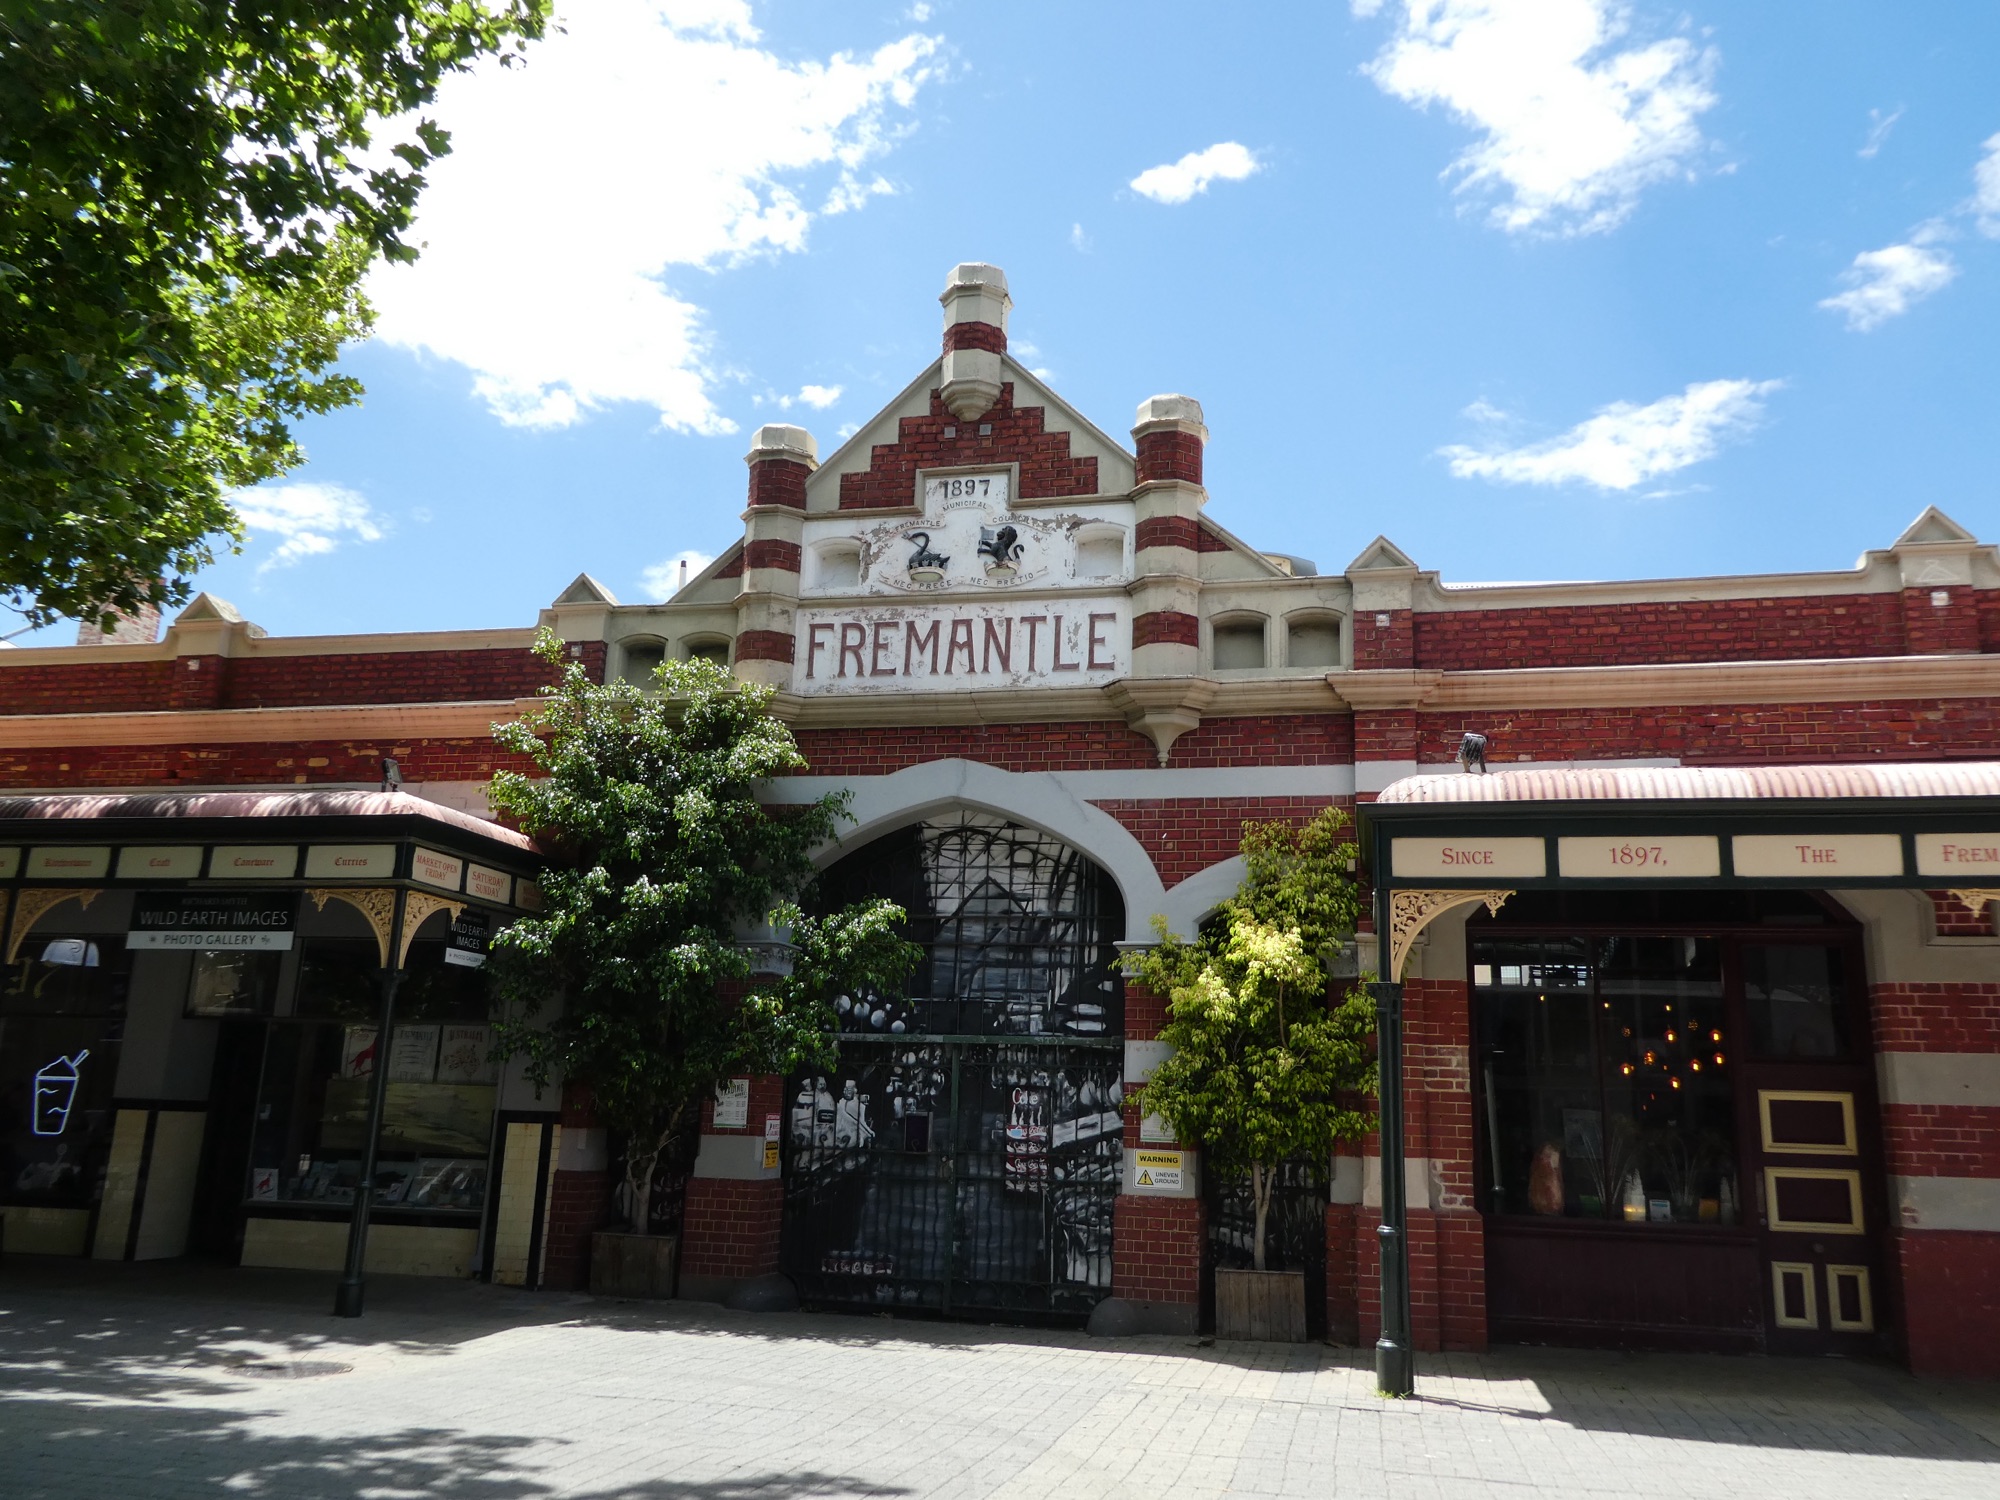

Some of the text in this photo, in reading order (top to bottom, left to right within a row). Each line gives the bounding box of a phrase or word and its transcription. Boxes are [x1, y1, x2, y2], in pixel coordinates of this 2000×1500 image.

[942, 478, 991, 499] 1897
[895, 519, 941, 532] FREMANTLE
[943, 500, 988, 512] MUNICIPAL
[893, 572, 1034, 590] NEC PRECE NEC PRETIO
[805, 611, 1117, 680] FREMANTLE
[233, 857, 274, 867] Caneware
[334, 856, 368, 867] Curries
[1608, 844, 1668, 867] 1897,
[416, 854, 458, 874] MARKET OPEN
[424, 867, 448, 881] FRIDAY
[471, 870, 506, 887] SATURDAY
[474, 883, 501, 898] SUNDAY
[139, 911, 289, 926] WILD EARTH IMAGES
[450, 921, 488, 938] WILD EARTH
[163, 934, 257, 945] PHOTO GALLERY
[456, 935, 480, 950] IMAGES
[1139, 1155, 1179, 1164] WARNING
